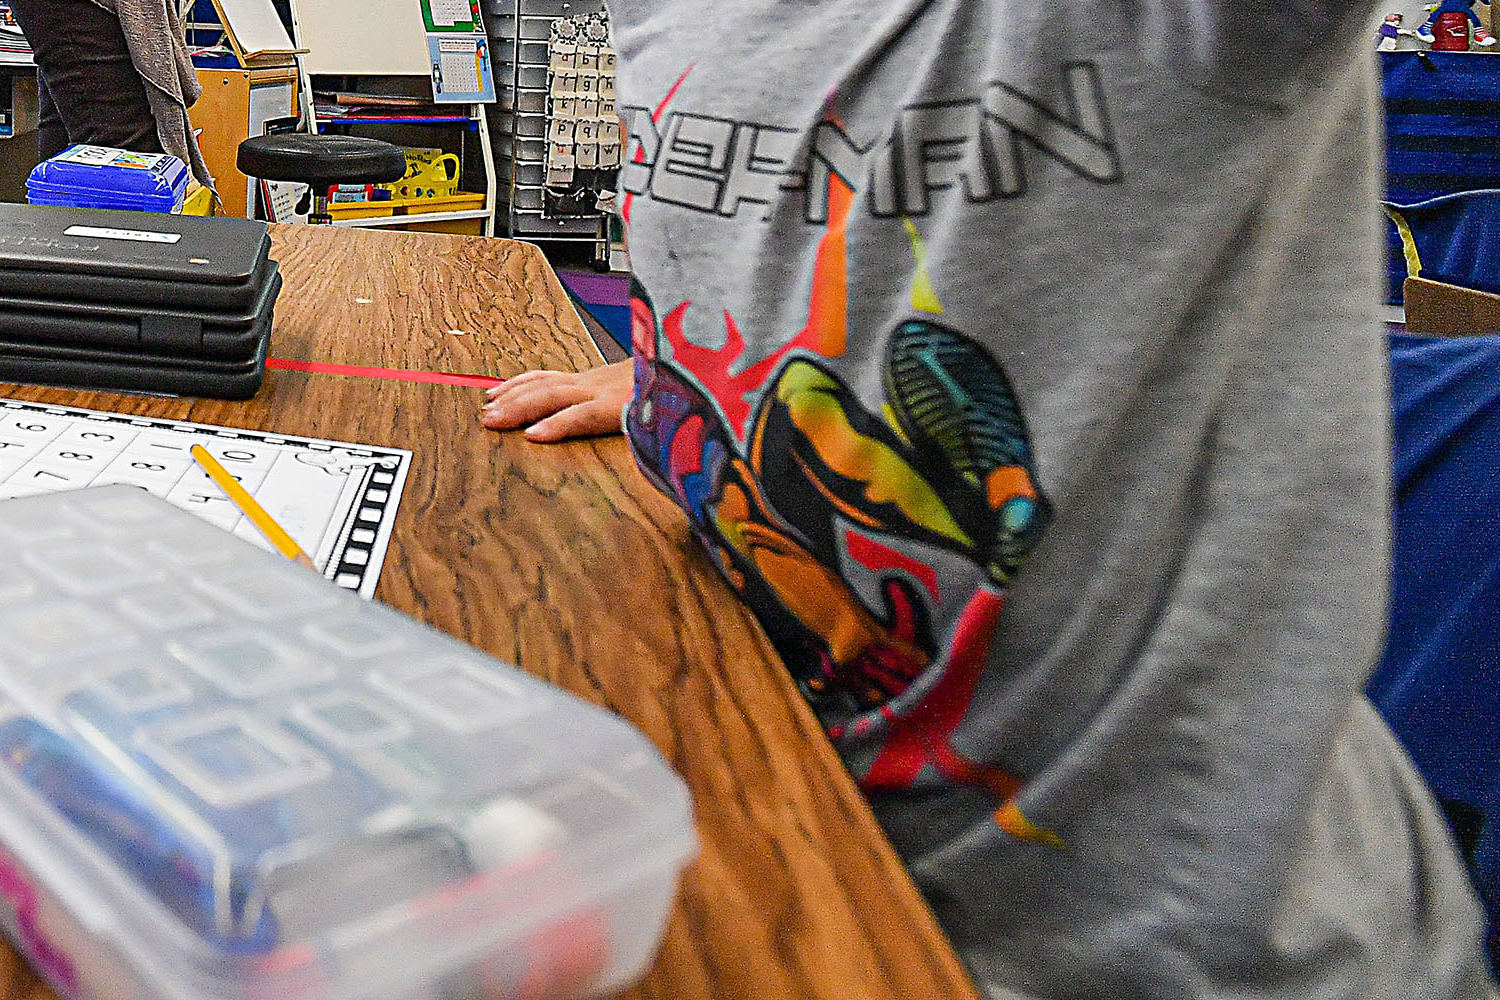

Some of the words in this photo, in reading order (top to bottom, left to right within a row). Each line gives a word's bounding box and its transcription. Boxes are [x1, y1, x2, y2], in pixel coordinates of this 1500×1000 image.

[15, 422, 47, 432] 6
[34, 470, 70, 481] 7
[59, 451, 94, 461] 8
[80, 431, 116, 443] 3
[219, 450, 257, 465] 10
[131, 462, 167, 472] 8
